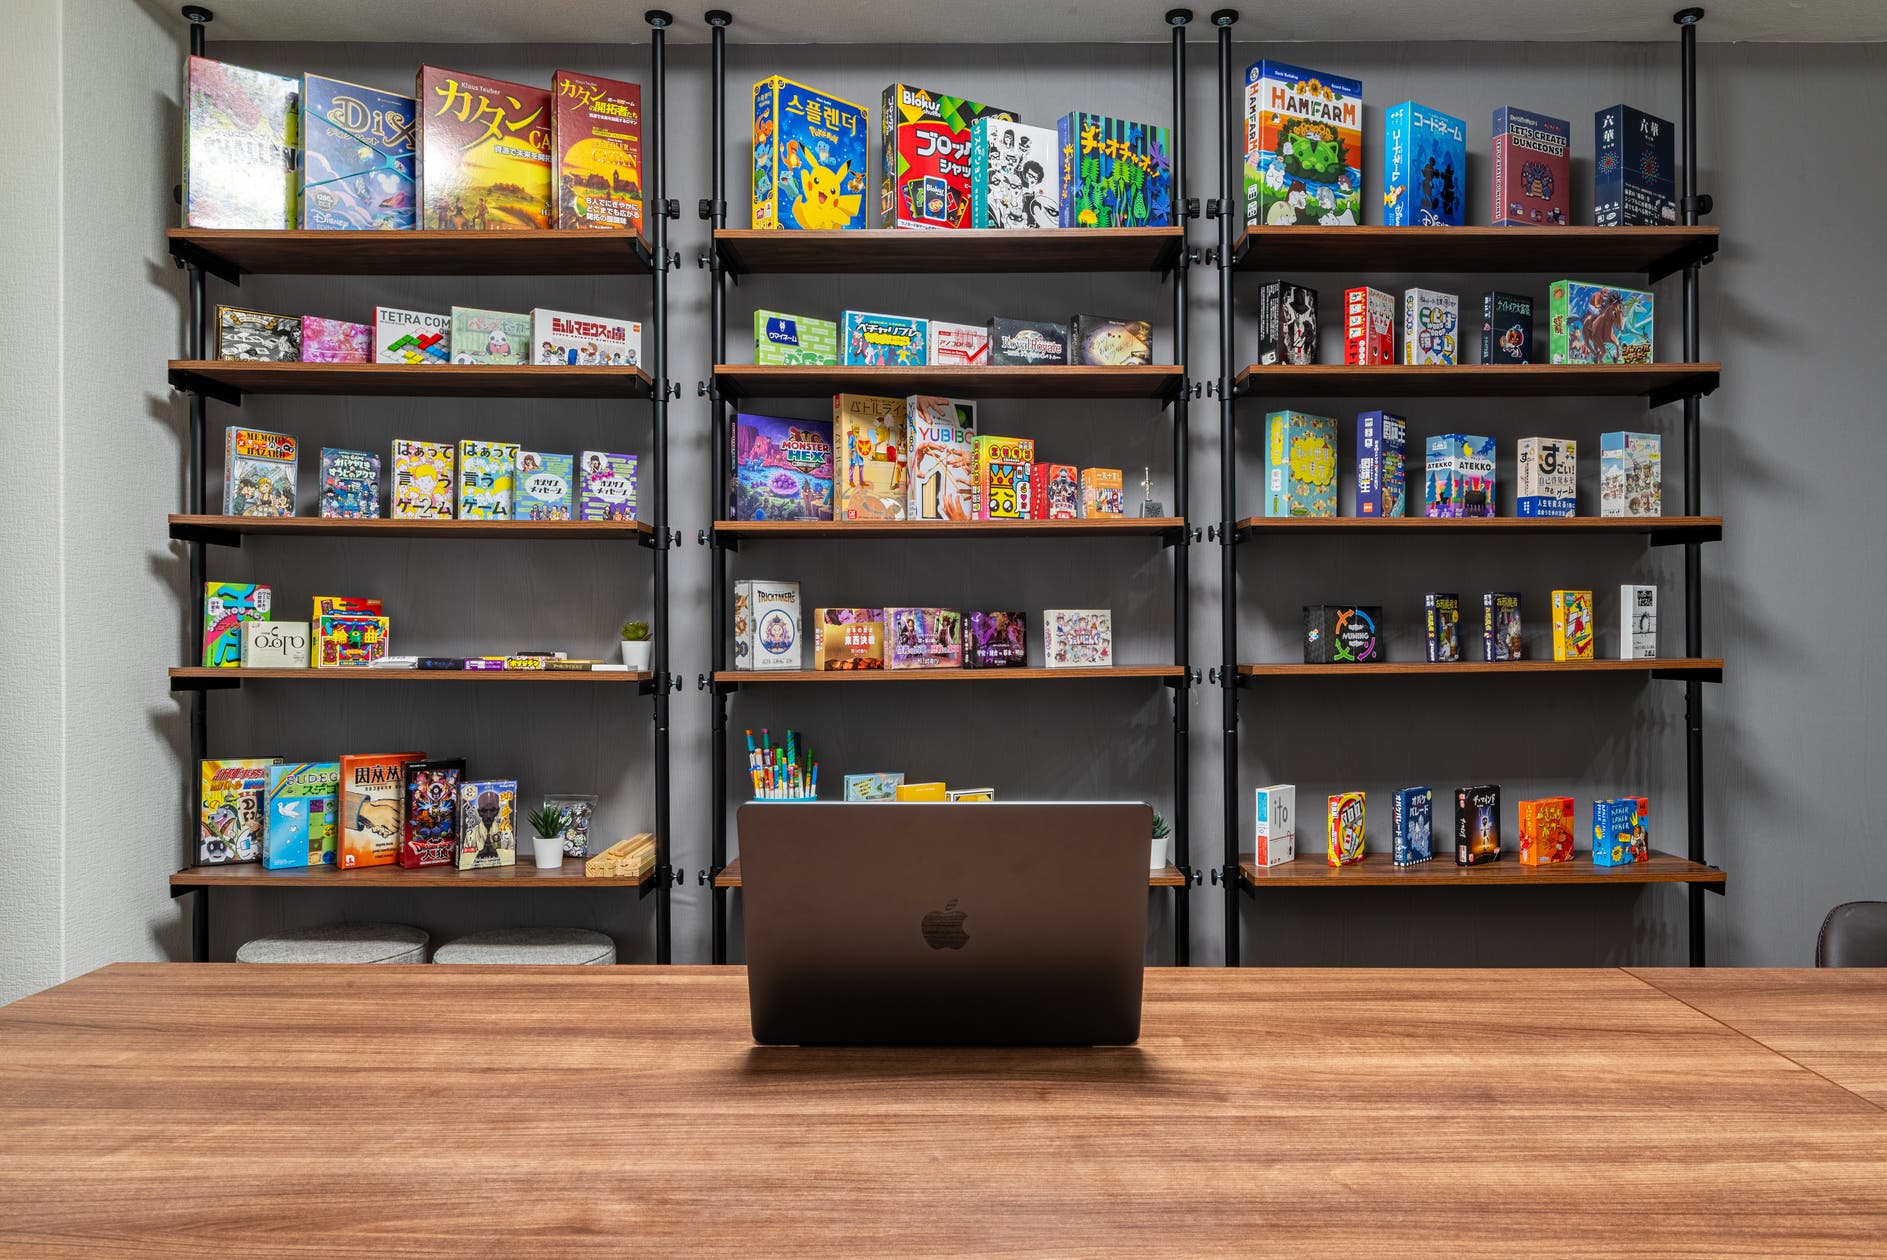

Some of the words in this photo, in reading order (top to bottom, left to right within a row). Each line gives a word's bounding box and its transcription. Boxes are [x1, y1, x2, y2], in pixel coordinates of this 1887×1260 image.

[461, 82, 478, 90] Klaus
[479, 85, 501, 96] Teuber
[559, 79, 606, 111] カタン
[903, 90, 942, 113] Blokus
[1271, 86, 1356, 126] HAMFARM
[435, 79, 544, 152] カタン
[785, 94, 857, 137] 스플렌더
[1414, 111, 1463, 142] コードネーム
[1510, 124, 1533, 139] LET'S
[1534, 129, 1566, 147] CREATE
[1513, 136, 1564, 157] DUNGEONS!
[380, 310, 422, 327] TETRA
[919, 427, 973, 446] YUBIBO
[397, 442, 453, 459] はぁって
[463, 442, 519, 459] はぁって
[781, 441, 829, 453] MONSTER
[787, 450, 826, 463] HEX
[1427, 460, 1452, 470] ATEKKO
[1539, 443, 1575, 475] すごい!
[1459, 461, 1492, 472] ATEKKO
[397, 470, 452, 489] 言う
[463, 471, 494, 488] 言う
[463, 498, 507, 516] ゲーム
[286, 772, 337, 787] SUDEG
[1411, 795, 1427, 806] オバケ
[1274, 796, 1288, 829] ito
[1409, 805, 1430, 817] パレード
